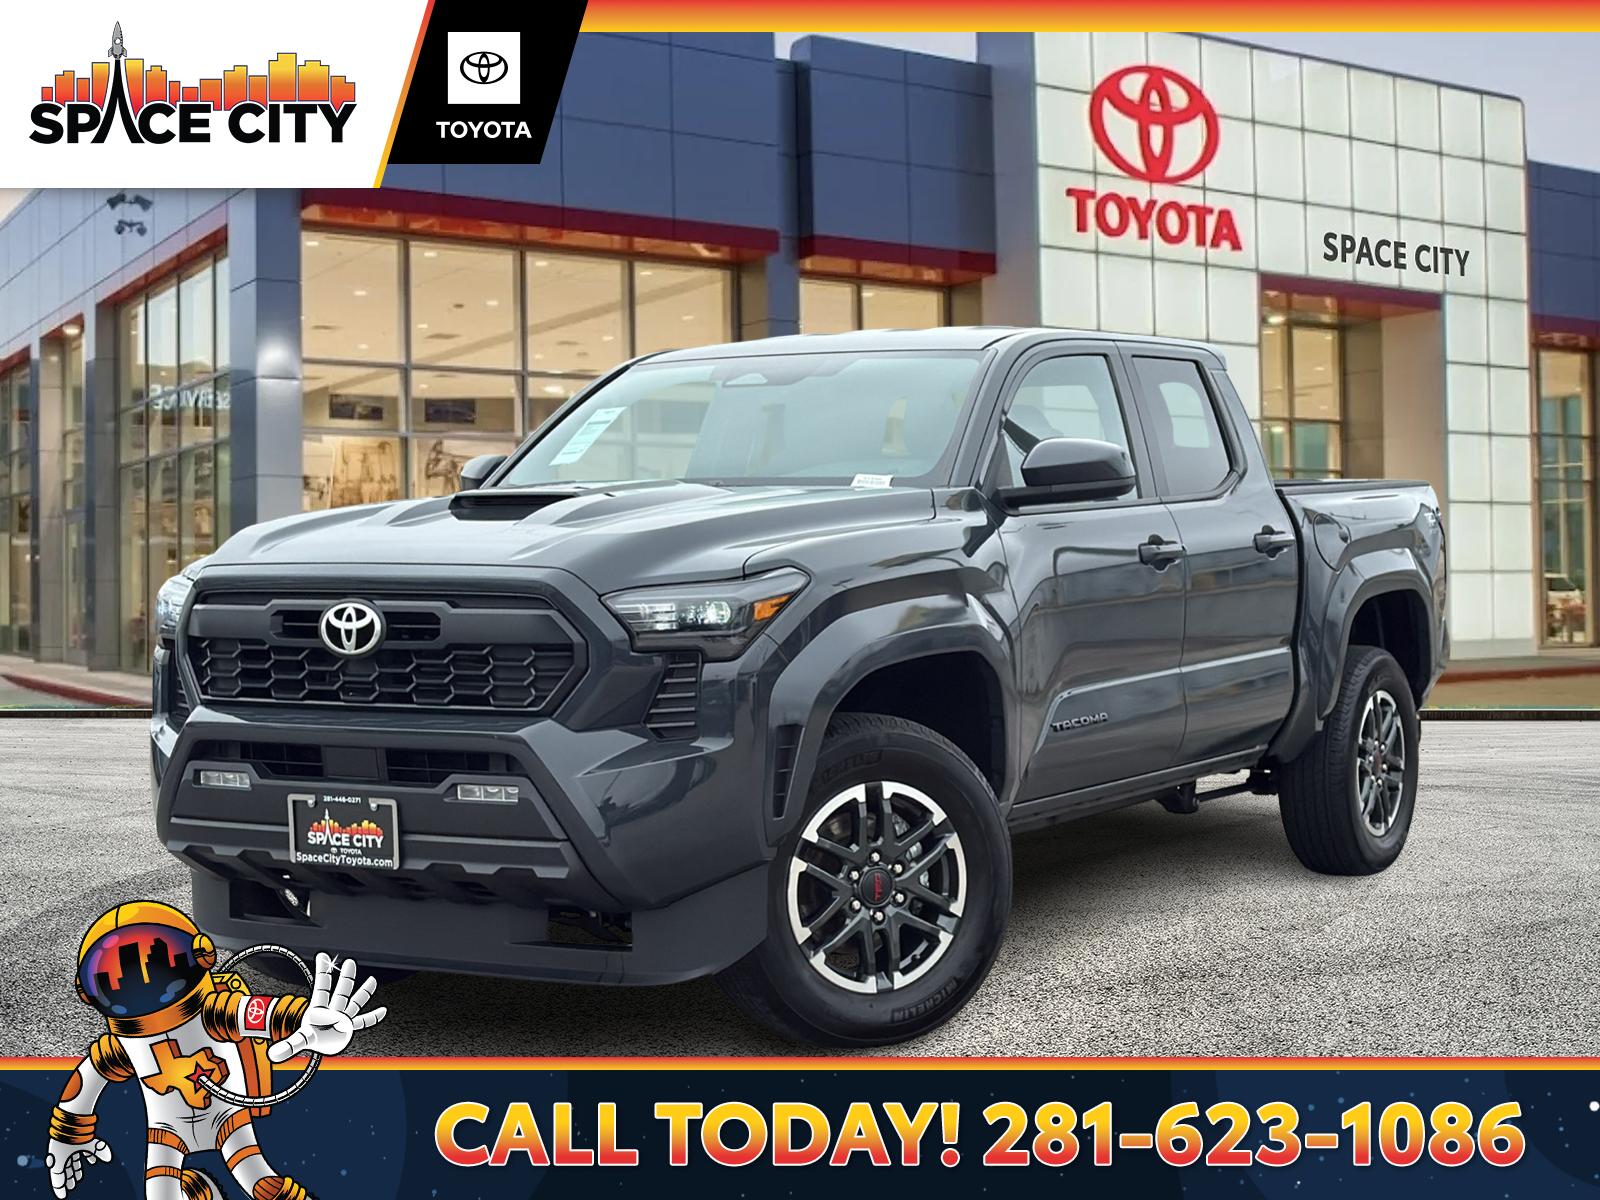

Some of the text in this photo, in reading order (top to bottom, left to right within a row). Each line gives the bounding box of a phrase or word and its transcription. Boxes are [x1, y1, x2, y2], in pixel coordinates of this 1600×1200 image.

[1065, 188, 1242, 251] TOYOTA
[1323, 232, 1470, 277] SPACE CITY
[1052, 712, 1109, 731] TACOMA
[307, 824, 384, 848] SPACE CITY
[296, 852, 393, 867] SpaceCityToyota.com
[340, 847, 362, 855] TOYOTA
